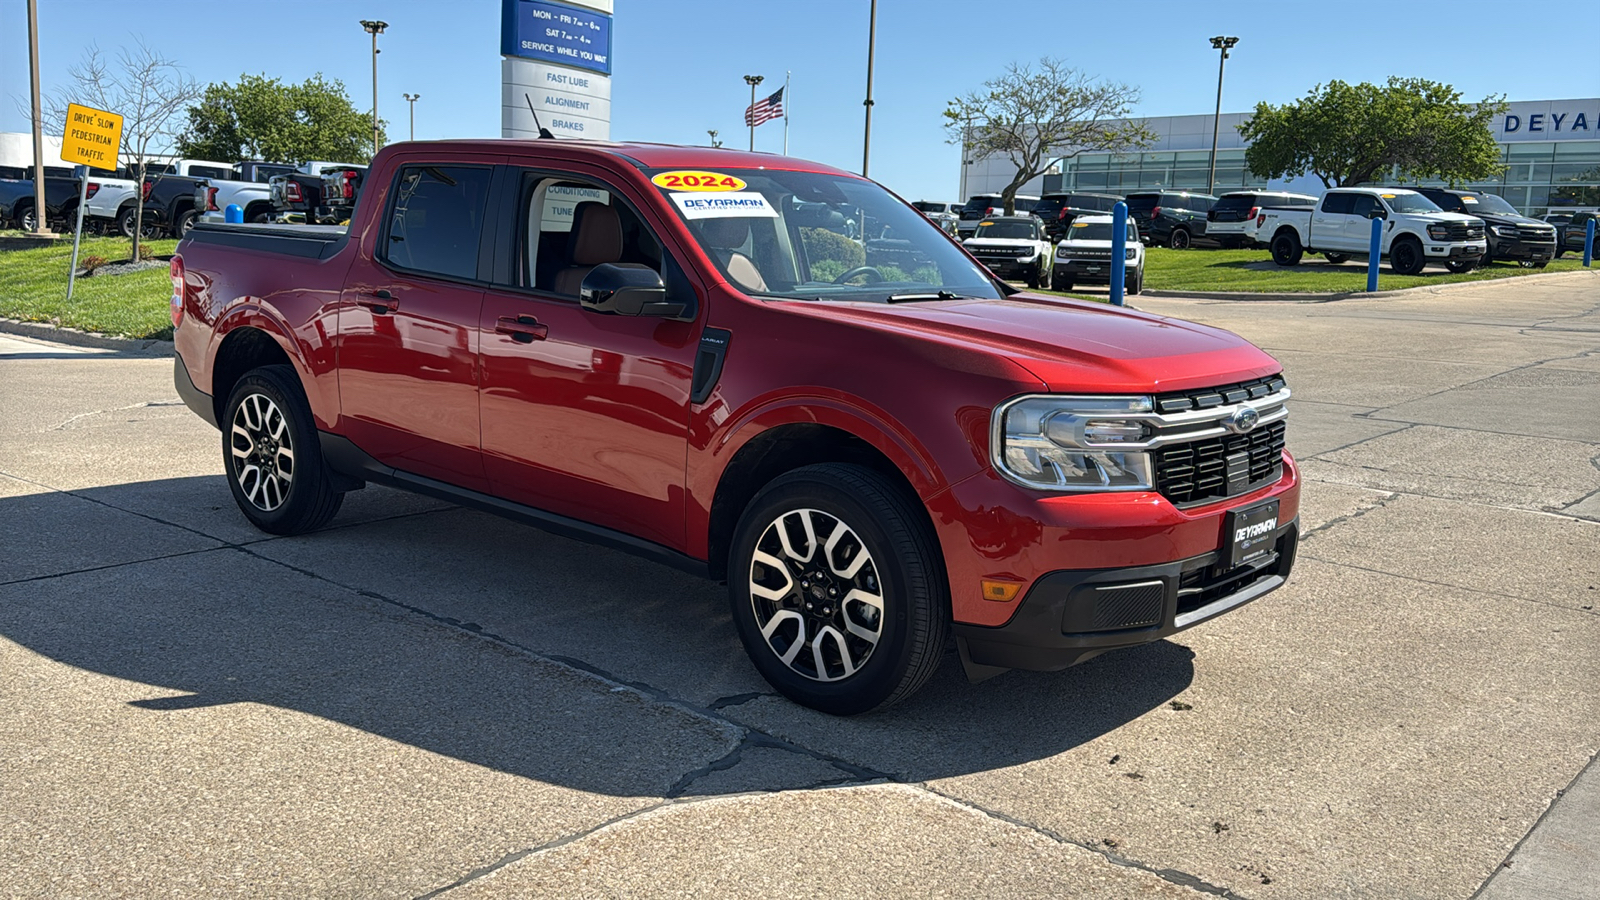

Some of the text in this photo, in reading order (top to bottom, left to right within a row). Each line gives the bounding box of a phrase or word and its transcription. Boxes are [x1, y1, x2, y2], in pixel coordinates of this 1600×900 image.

[533, 9, 551, 20] MON
[560, 14, 572, 24] FRI
[546, 28, 559, 38] SAT
[521, 40, 607, 64] SERVICE WHILE YOU WAIT
[546, 73, 589, 88] FAST LUBE
[545, 96, 590, 111] ALIGNMENT
[74, 113, 114, 129] DRIVE SLOW
[552, 119, 584, 132] BRAKES
[1504, 112, 1600, 132] DEYA
[72, 129, 111, 145] PEDESTRIAN
[77, 147, 104, 160] TRAFFIC
[663, 175, 738, 188] 2024
[547, 186, 600, 199] CONDITIONING
[683, 198, 764, 208] DEYARMAN
[1234, 517, 1277, 542] DEYARMAN
